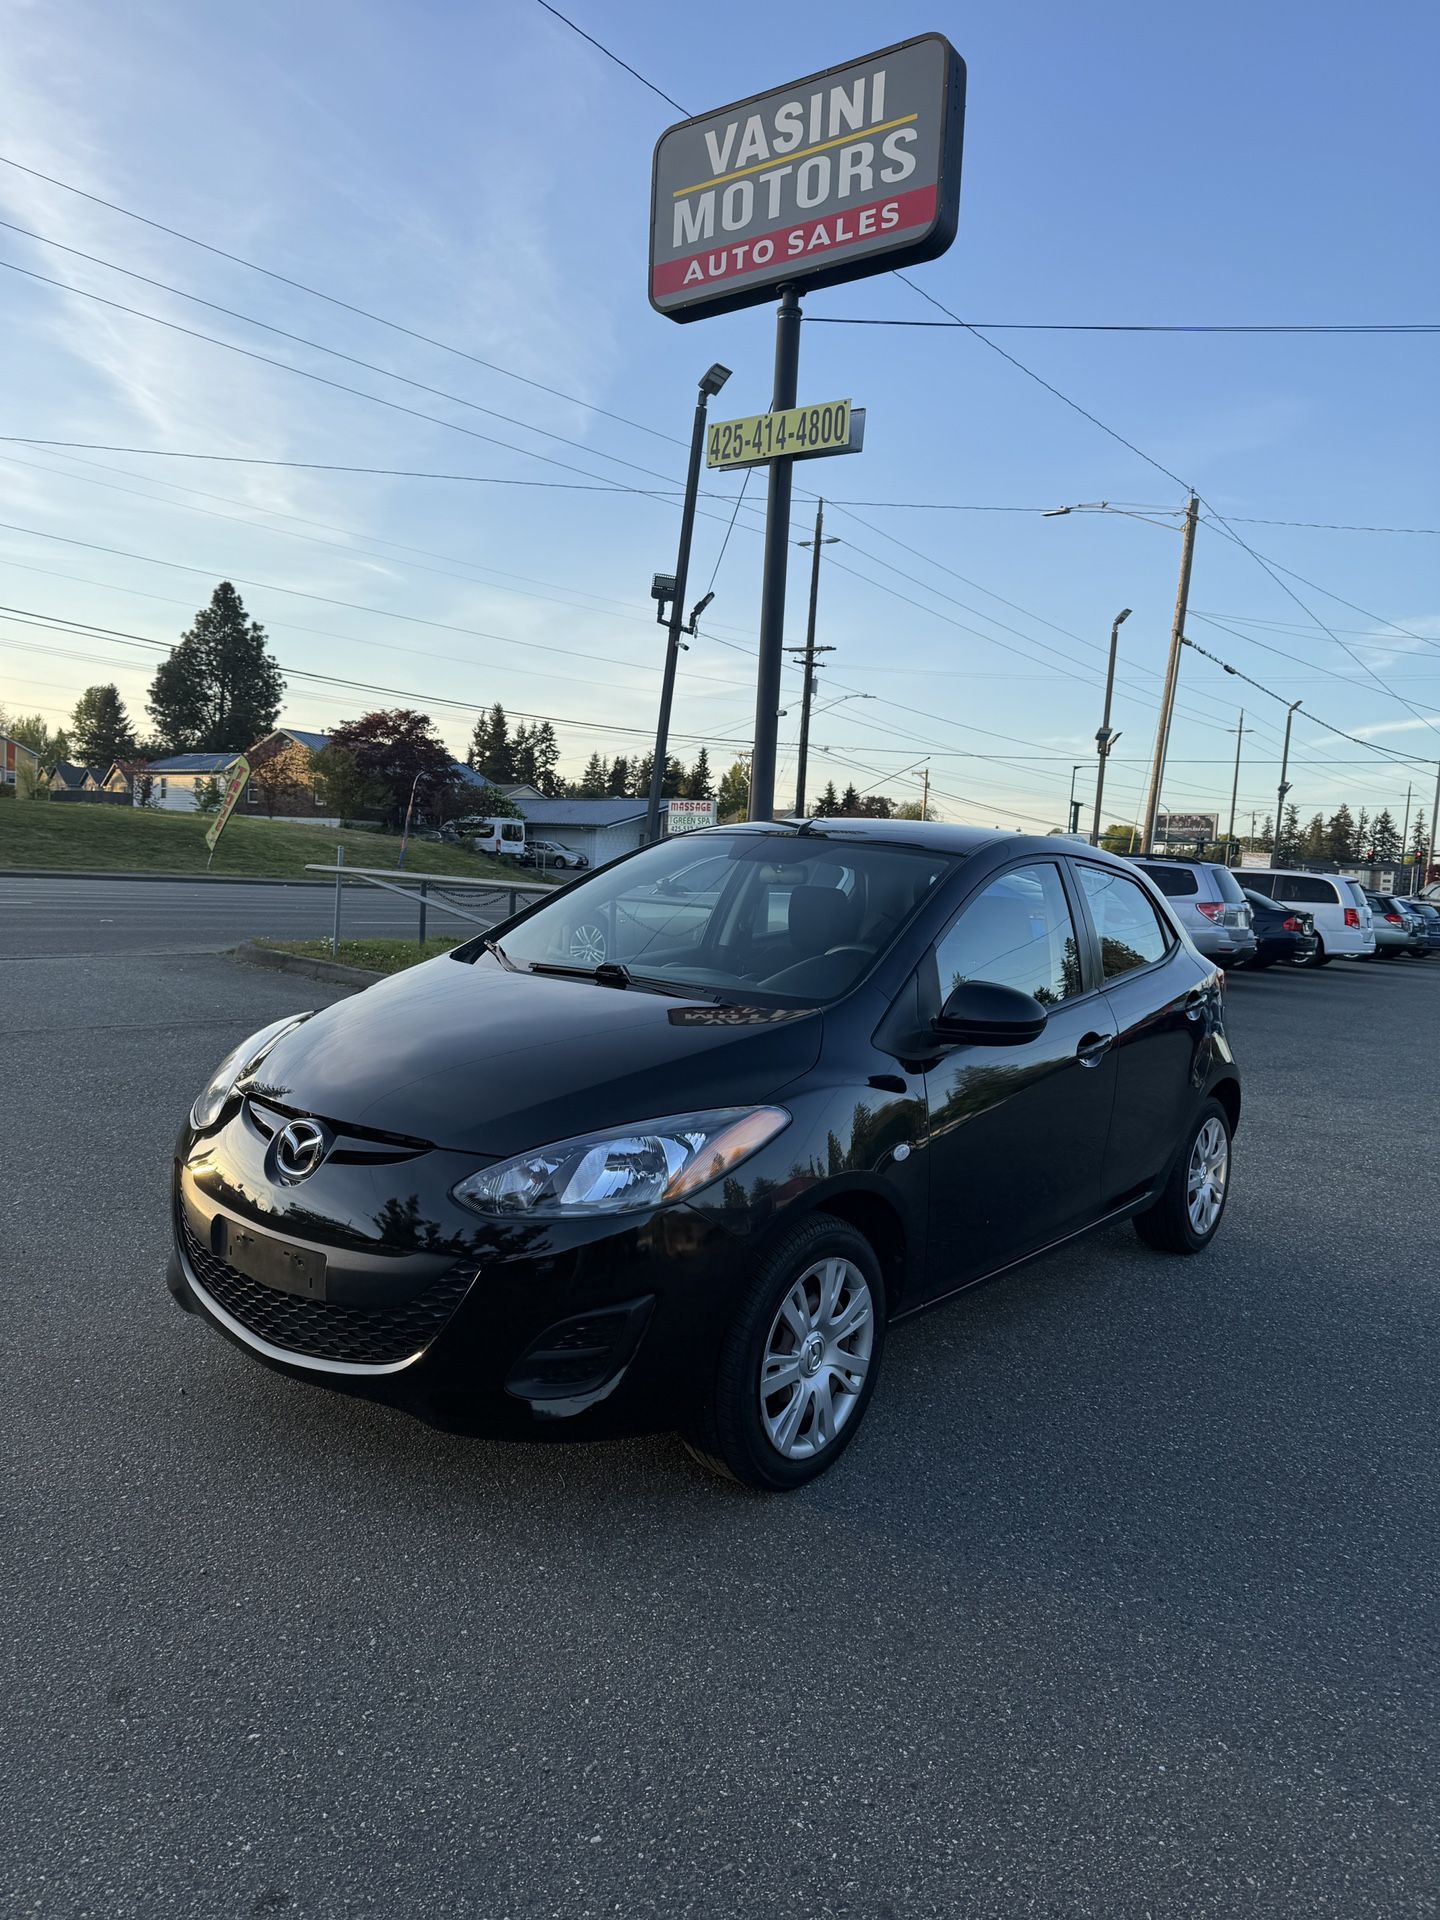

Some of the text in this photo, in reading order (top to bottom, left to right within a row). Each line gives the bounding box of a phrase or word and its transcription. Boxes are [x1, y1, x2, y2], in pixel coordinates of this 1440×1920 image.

[704, 70, 886, 175] VASINI
[672, 128, 918, 248] MOTORS
[683, 202, 899, 284] AUTO SALES
[710, 405, 846, 461] 425-414-4800
[671, 802, 711, 811] MASSAGE
[673, 817, 711, 825] GREEN SPA
